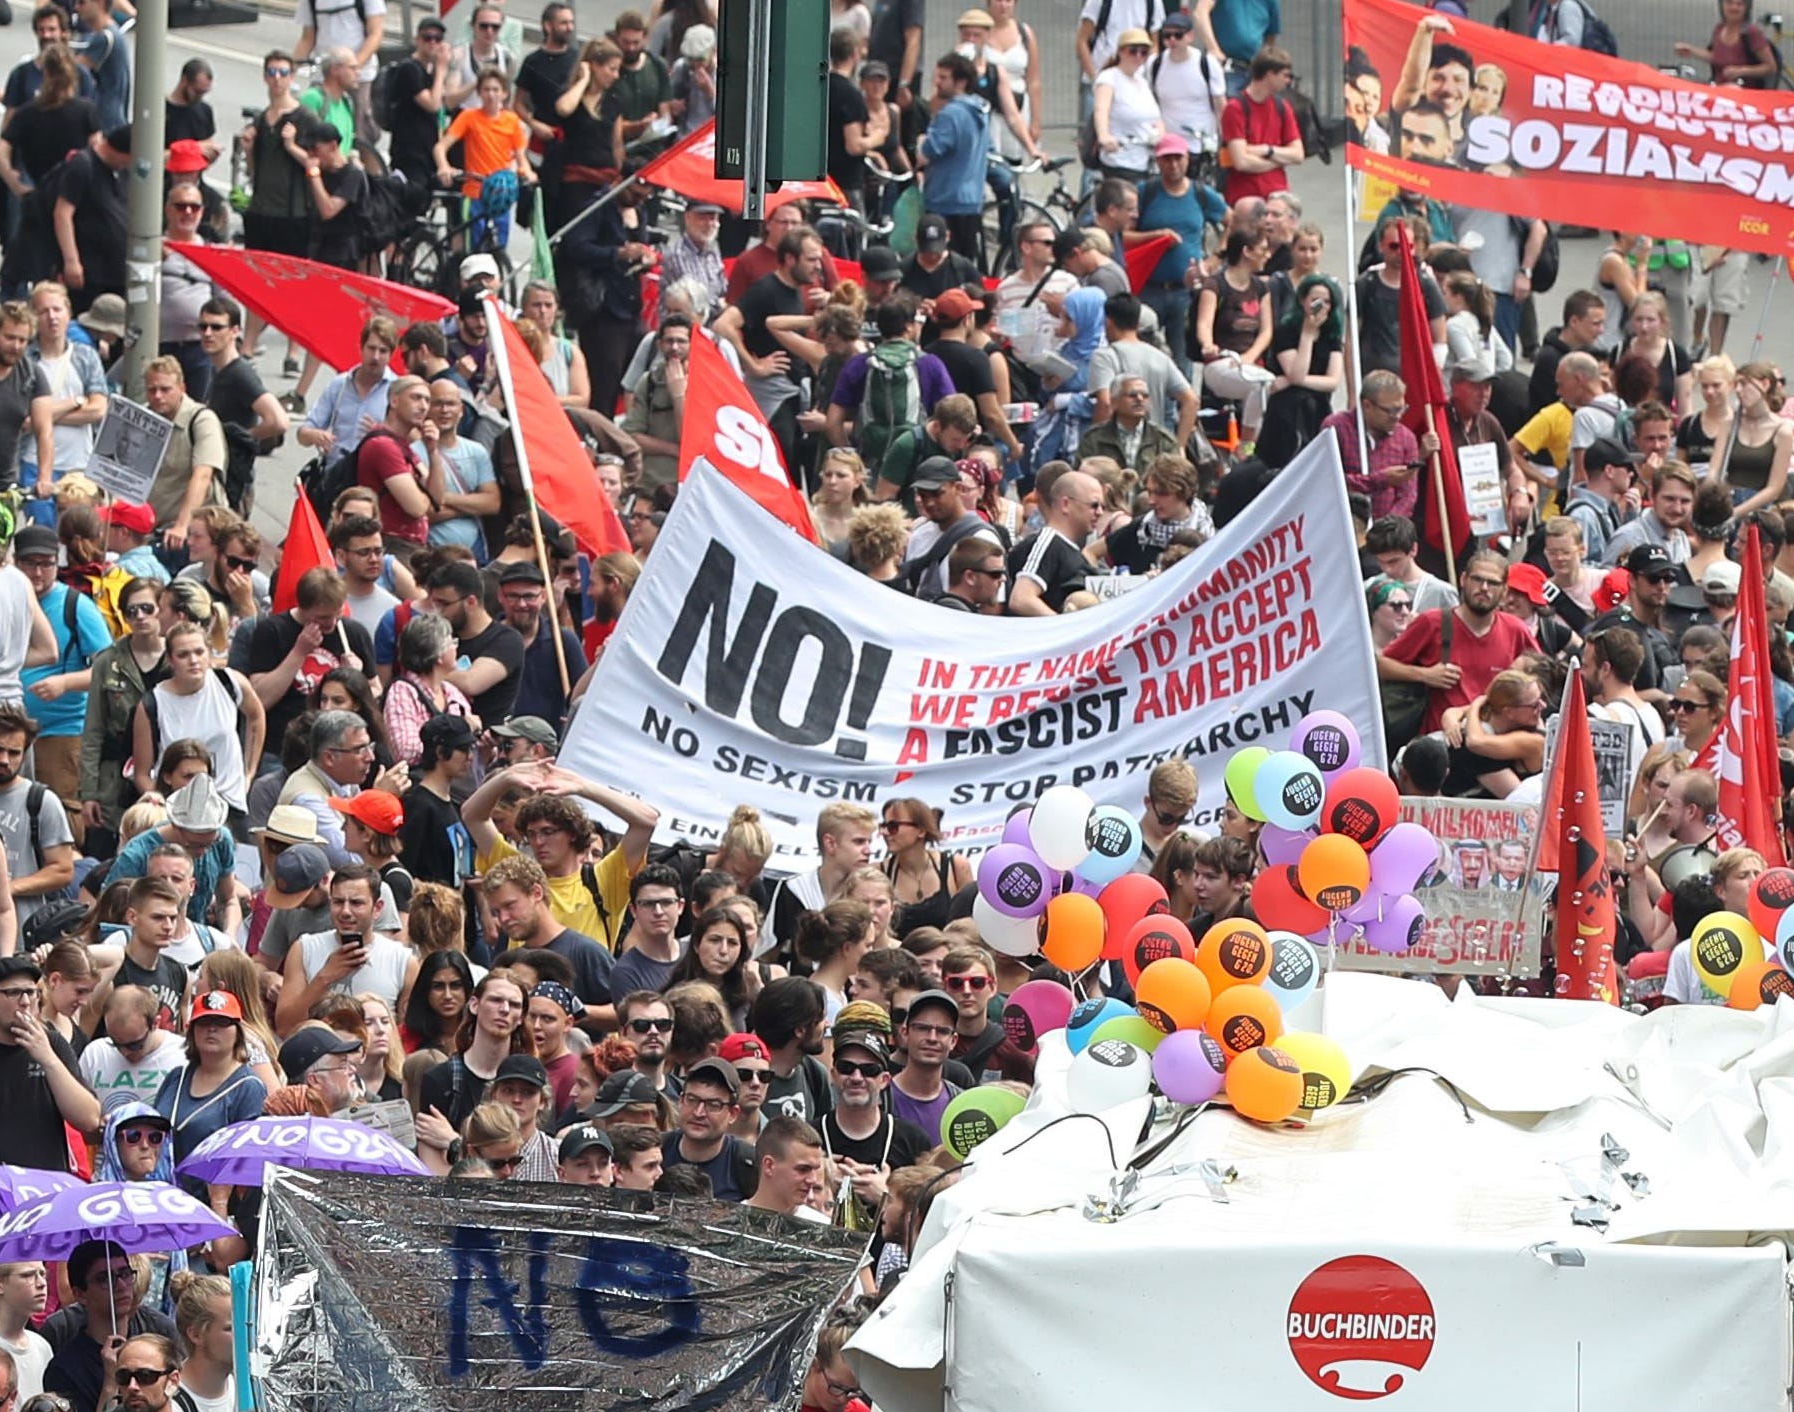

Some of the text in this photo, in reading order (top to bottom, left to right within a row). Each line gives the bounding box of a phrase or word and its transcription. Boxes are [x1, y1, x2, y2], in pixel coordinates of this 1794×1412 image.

[726, 147, 740, 166] K7b
[657, 537, 894, 763] NO!
[910, 694, 980, 734] WE
[1124, 633, 1187, 674] TO
[1189, 558, 1312, 662] ACCEPT
[917, 658, 958, 693] IN
[967, 661, 1033, 697] THE
[1132, 607, 1322, 725] AMERICA
[1308, 729, 1341, 742] JUGEND
[640, 706, 880, 802] NO SEXISM
[1313, 741, 1340, 755] GEGEN
[1284, 774, 1312, 798] JUGEND
[1293, 785, 1318, 805] GEGEN
[1100, 817, 1128, 836] JUGEND
[1100, 827, 1125, 845] GEGEN
[1229, 932, 1261, 953] JUGEND
[1231, 943, 1259, 964] GEGEN
[1281, 940, 1312, 969] JUGEND
[1698, 931, 1725, 955] JUGEND
[1705, 941, 1731, 962] GEGEN
[1278, 948, 1305, 977] GEGEN
[226, 1124, 305, 1152] NO
[447, 1224, 700, 1378] NO
[1288, 1311, 1435, 1342] BUCHBINDER
